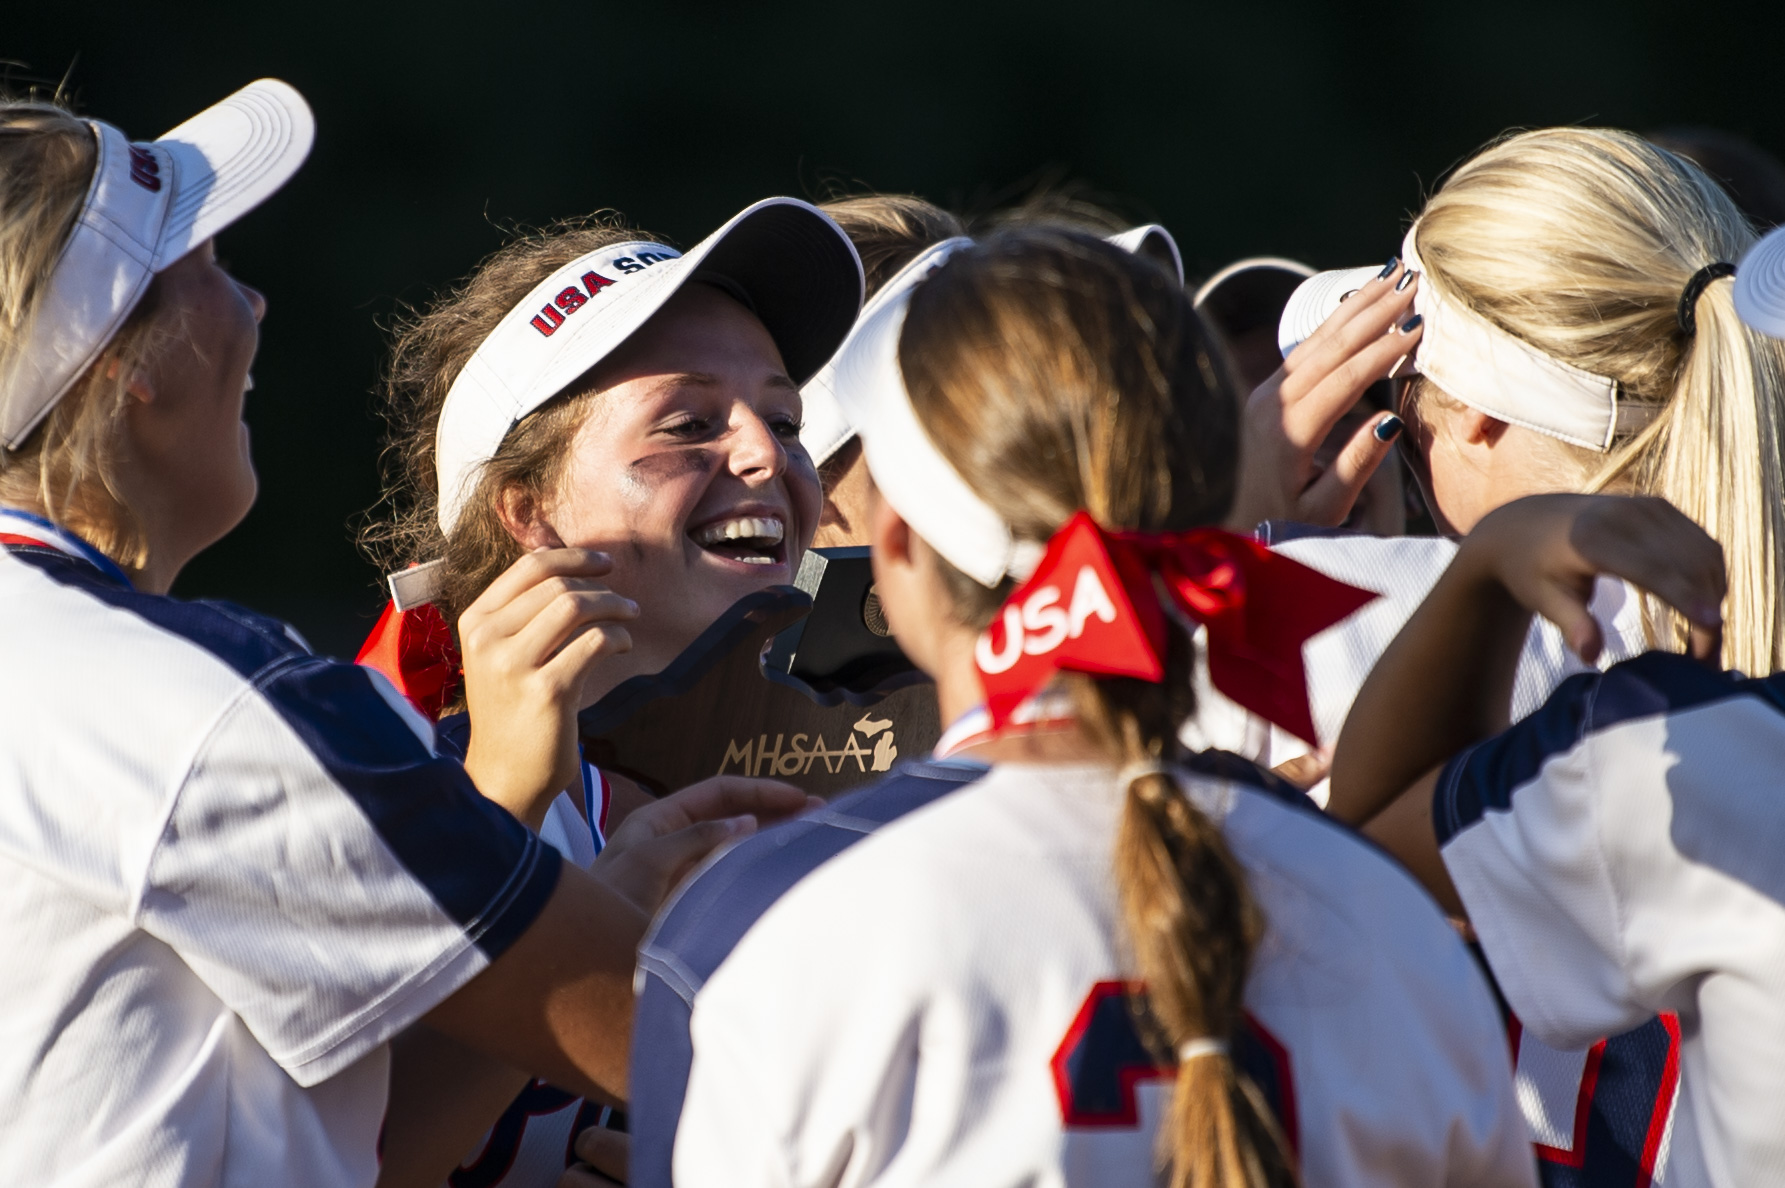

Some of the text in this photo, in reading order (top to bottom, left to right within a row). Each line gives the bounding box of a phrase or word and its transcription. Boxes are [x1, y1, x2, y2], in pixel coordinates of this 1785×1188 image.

[529, 270, 618, 338] USA
[975, 564, 1117, 674] USA
[716, 731, 872, 777] MHSAA
